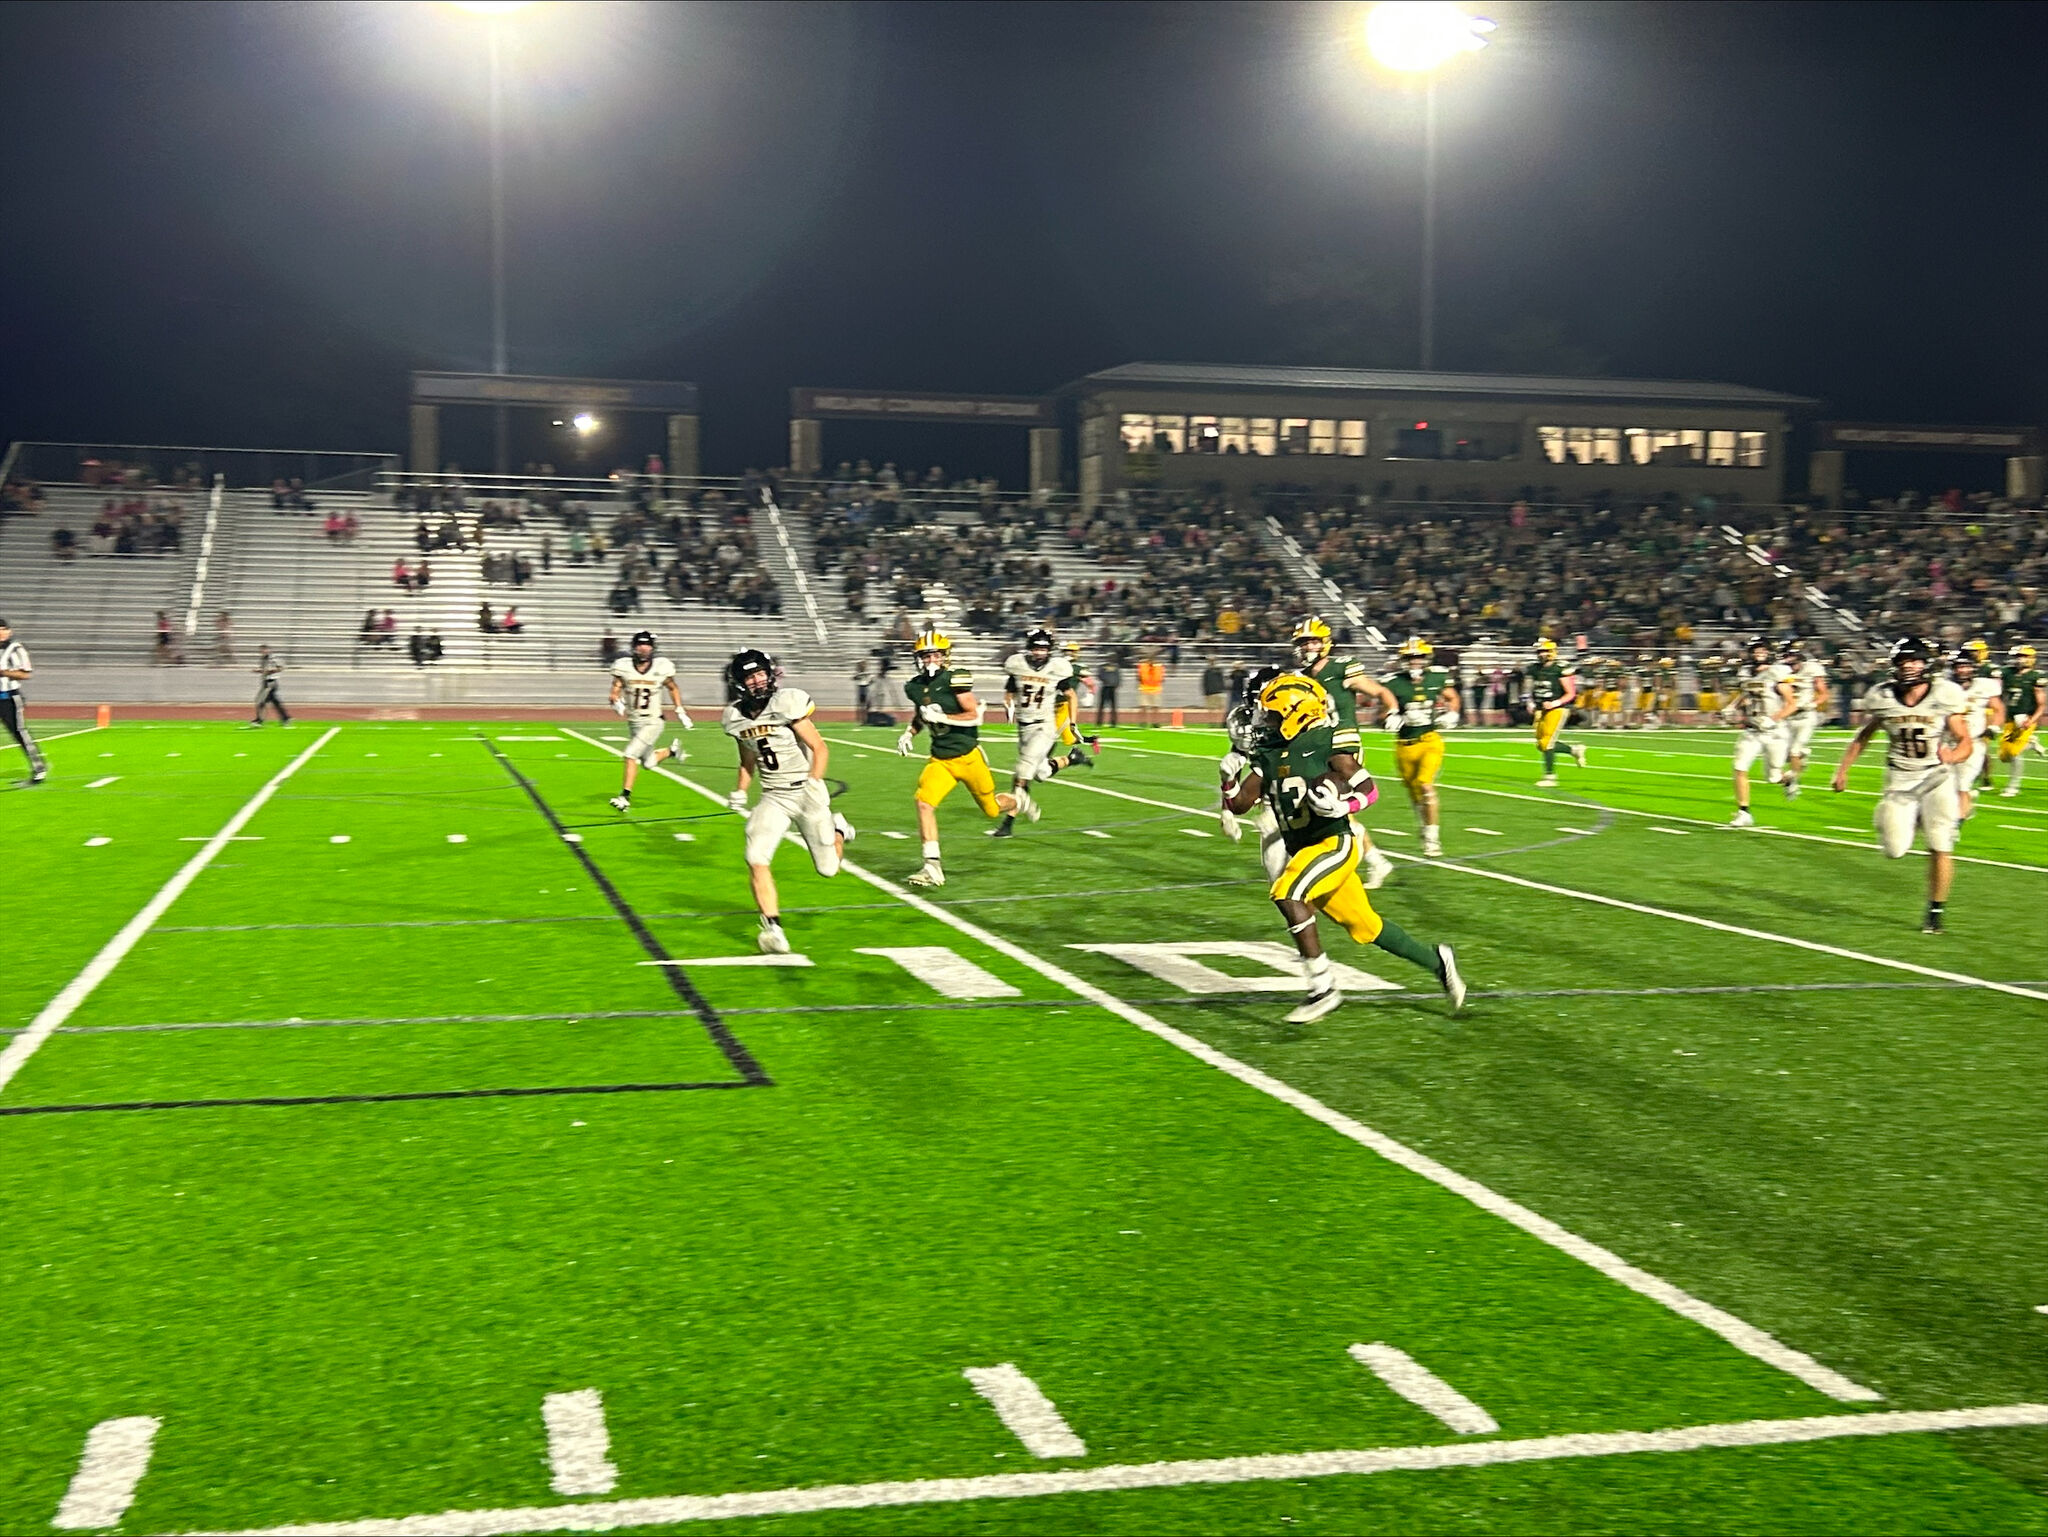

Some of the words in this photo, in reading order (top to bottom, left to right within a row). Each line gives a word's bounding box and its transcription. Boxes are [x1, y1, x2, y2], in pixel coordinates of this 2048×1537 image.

[633, 687, 651, 710] 13
[1021, 684, 1046, 709] 54
[756, 737, 779, 771] 6
[1268, 775, 1311, 831] 13
